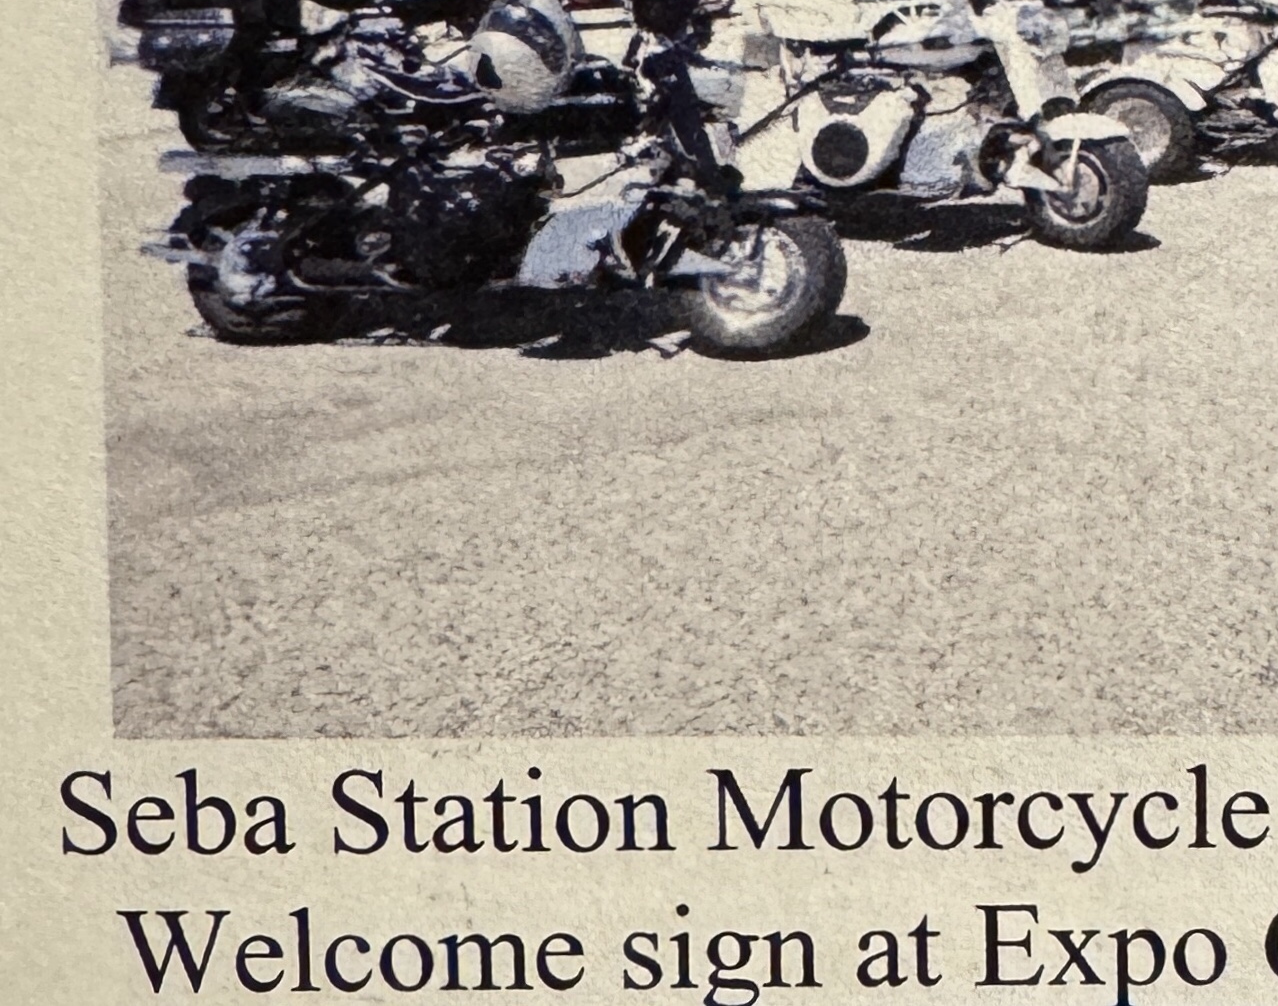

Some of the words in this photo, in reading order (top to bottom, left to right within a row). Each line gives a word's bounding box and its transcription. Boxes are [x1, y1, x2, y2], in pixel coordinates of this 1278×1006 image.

[61, 769, 295, 855] Seba
[333, 767, 676, 854] Station
[707, 764, 1269, 873] Motorcycle
[117, 907, 584, 993] Welcome
[624, 904, 822, 1006] sign
[857, 915, 942, 987] at
[975, 905, 1226, 1006] Expo
